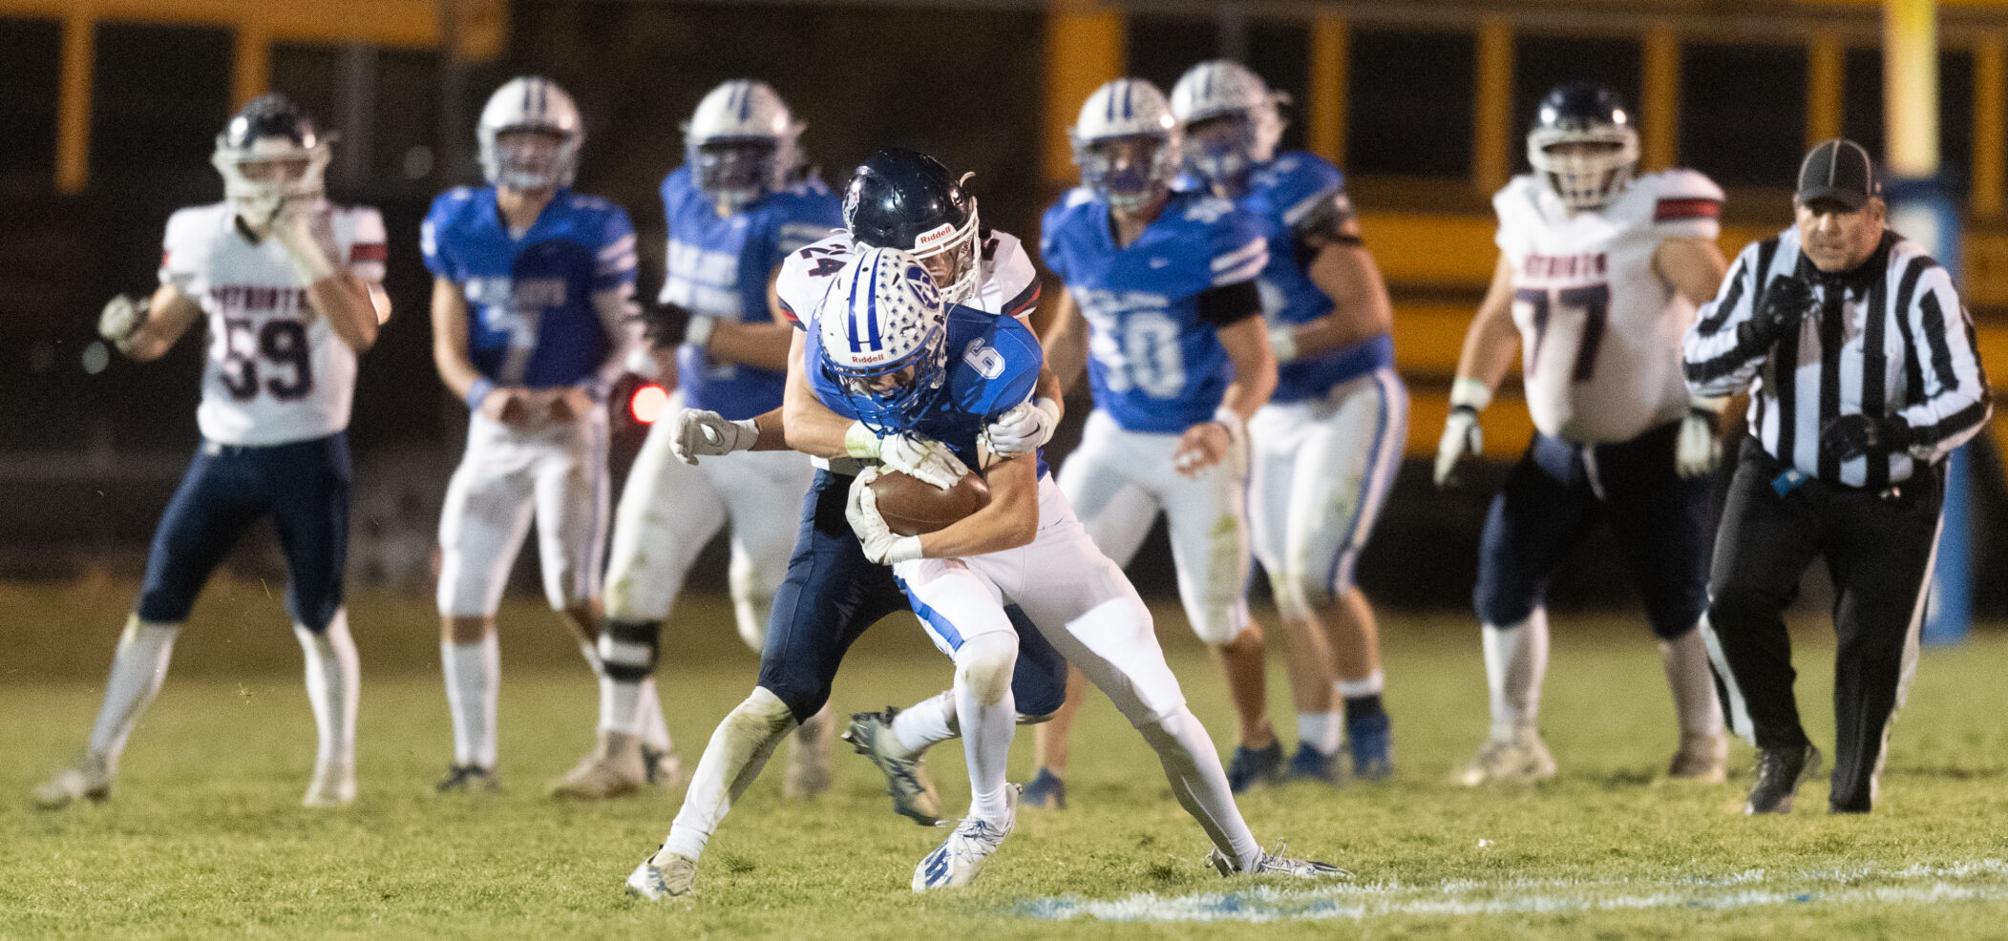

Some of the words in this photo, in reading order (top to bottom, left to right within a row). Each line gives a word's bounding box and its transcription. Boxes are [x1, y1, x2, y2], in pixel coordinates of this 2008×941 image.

[920, 226, 951, 245] Riddell
[1514, 284, 1611, 382] 77
[217, 318, 316, 402] 59
[851, 353, 884, 364] Riddell
[963, 337, 1006, 380] 6
